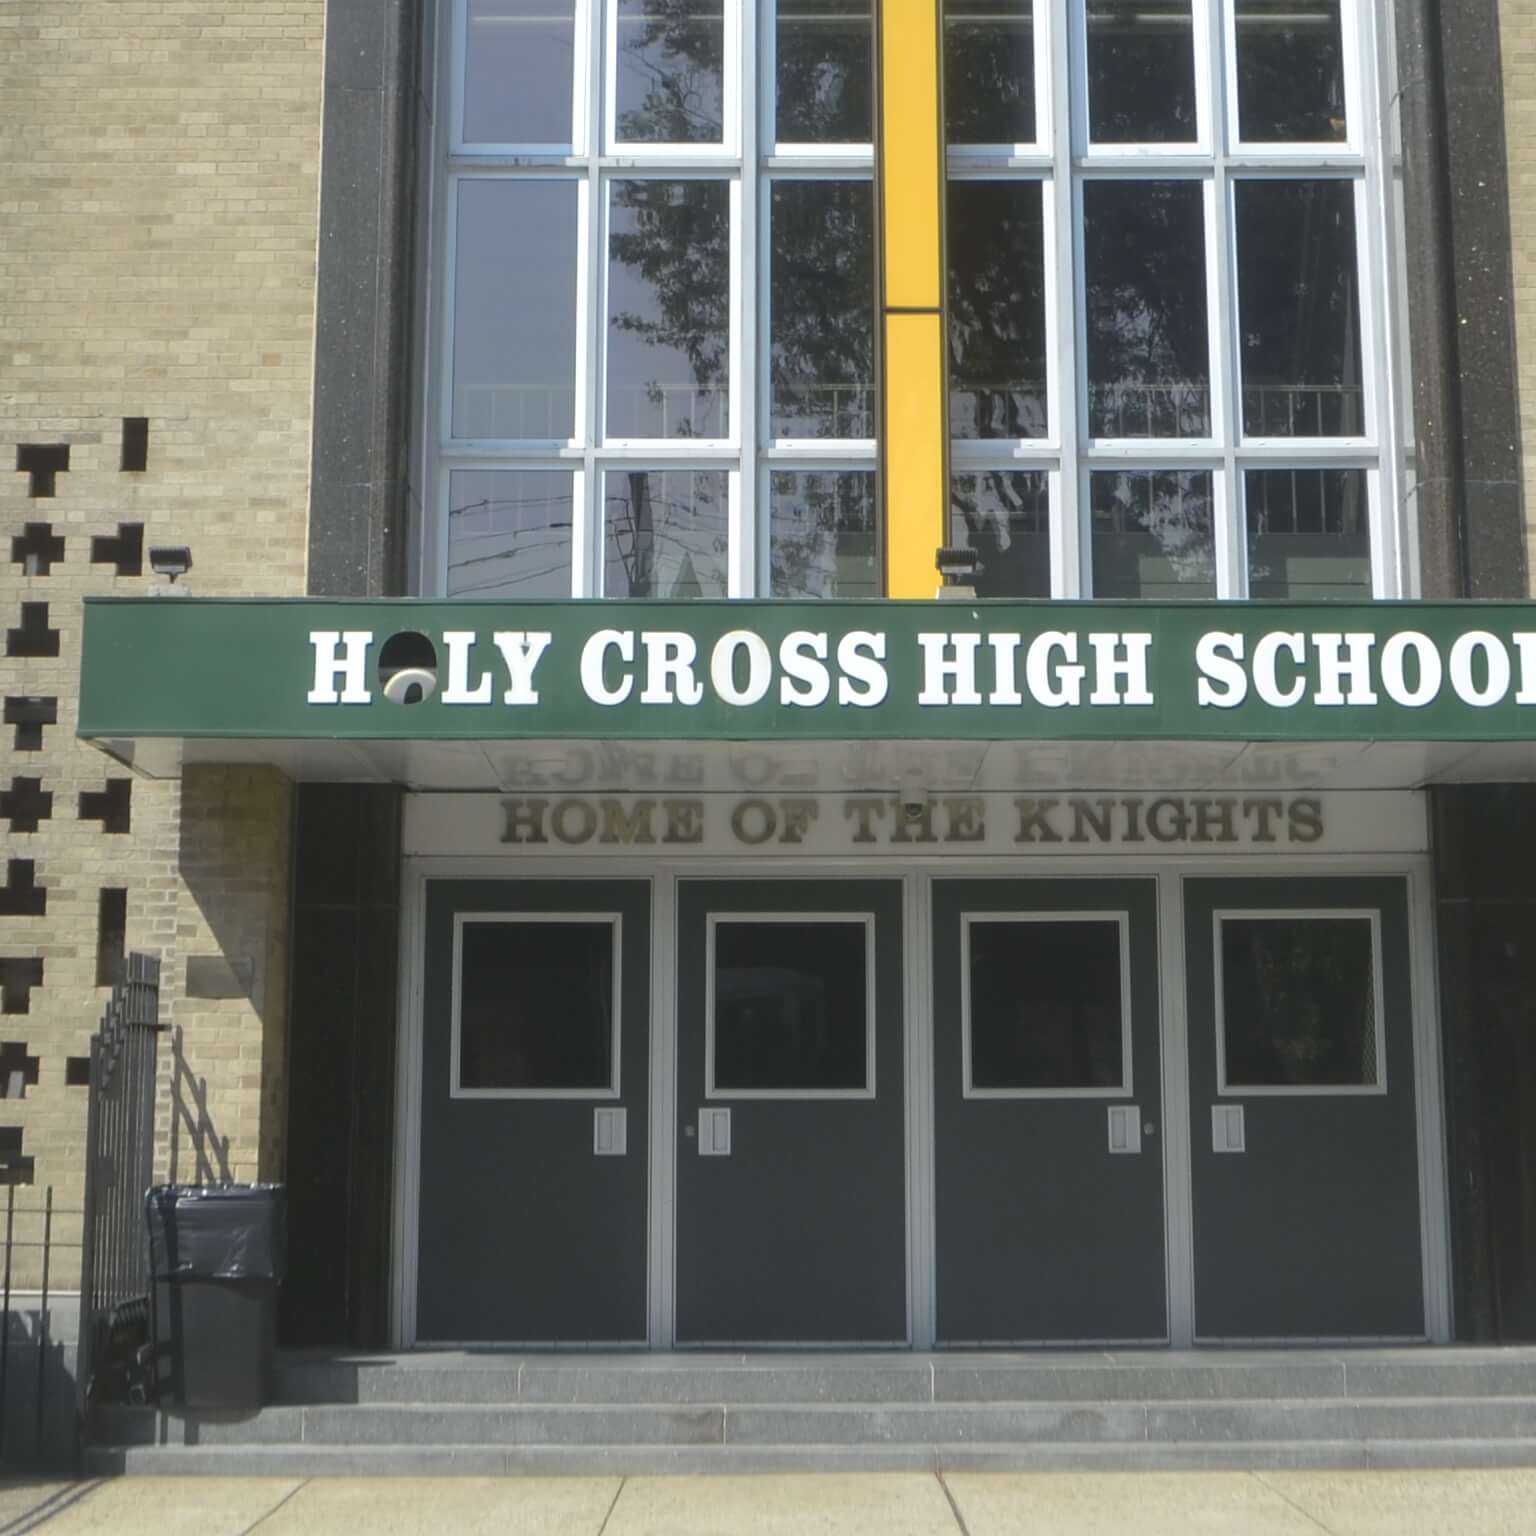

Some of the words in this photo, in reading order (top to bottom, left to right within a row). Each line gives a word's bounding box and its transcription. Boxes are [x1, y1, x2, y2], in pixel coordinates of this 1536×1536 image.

[579, 628, 889, 707] CROSS
[917, 630, 1155, 707] HIGH
[499, 798, 705, 845] HOME
[730, 798, 819, 844] OF
[843, 798, 986, 844] THE
[1012, 797, 1325, 843] KNIGHTS
